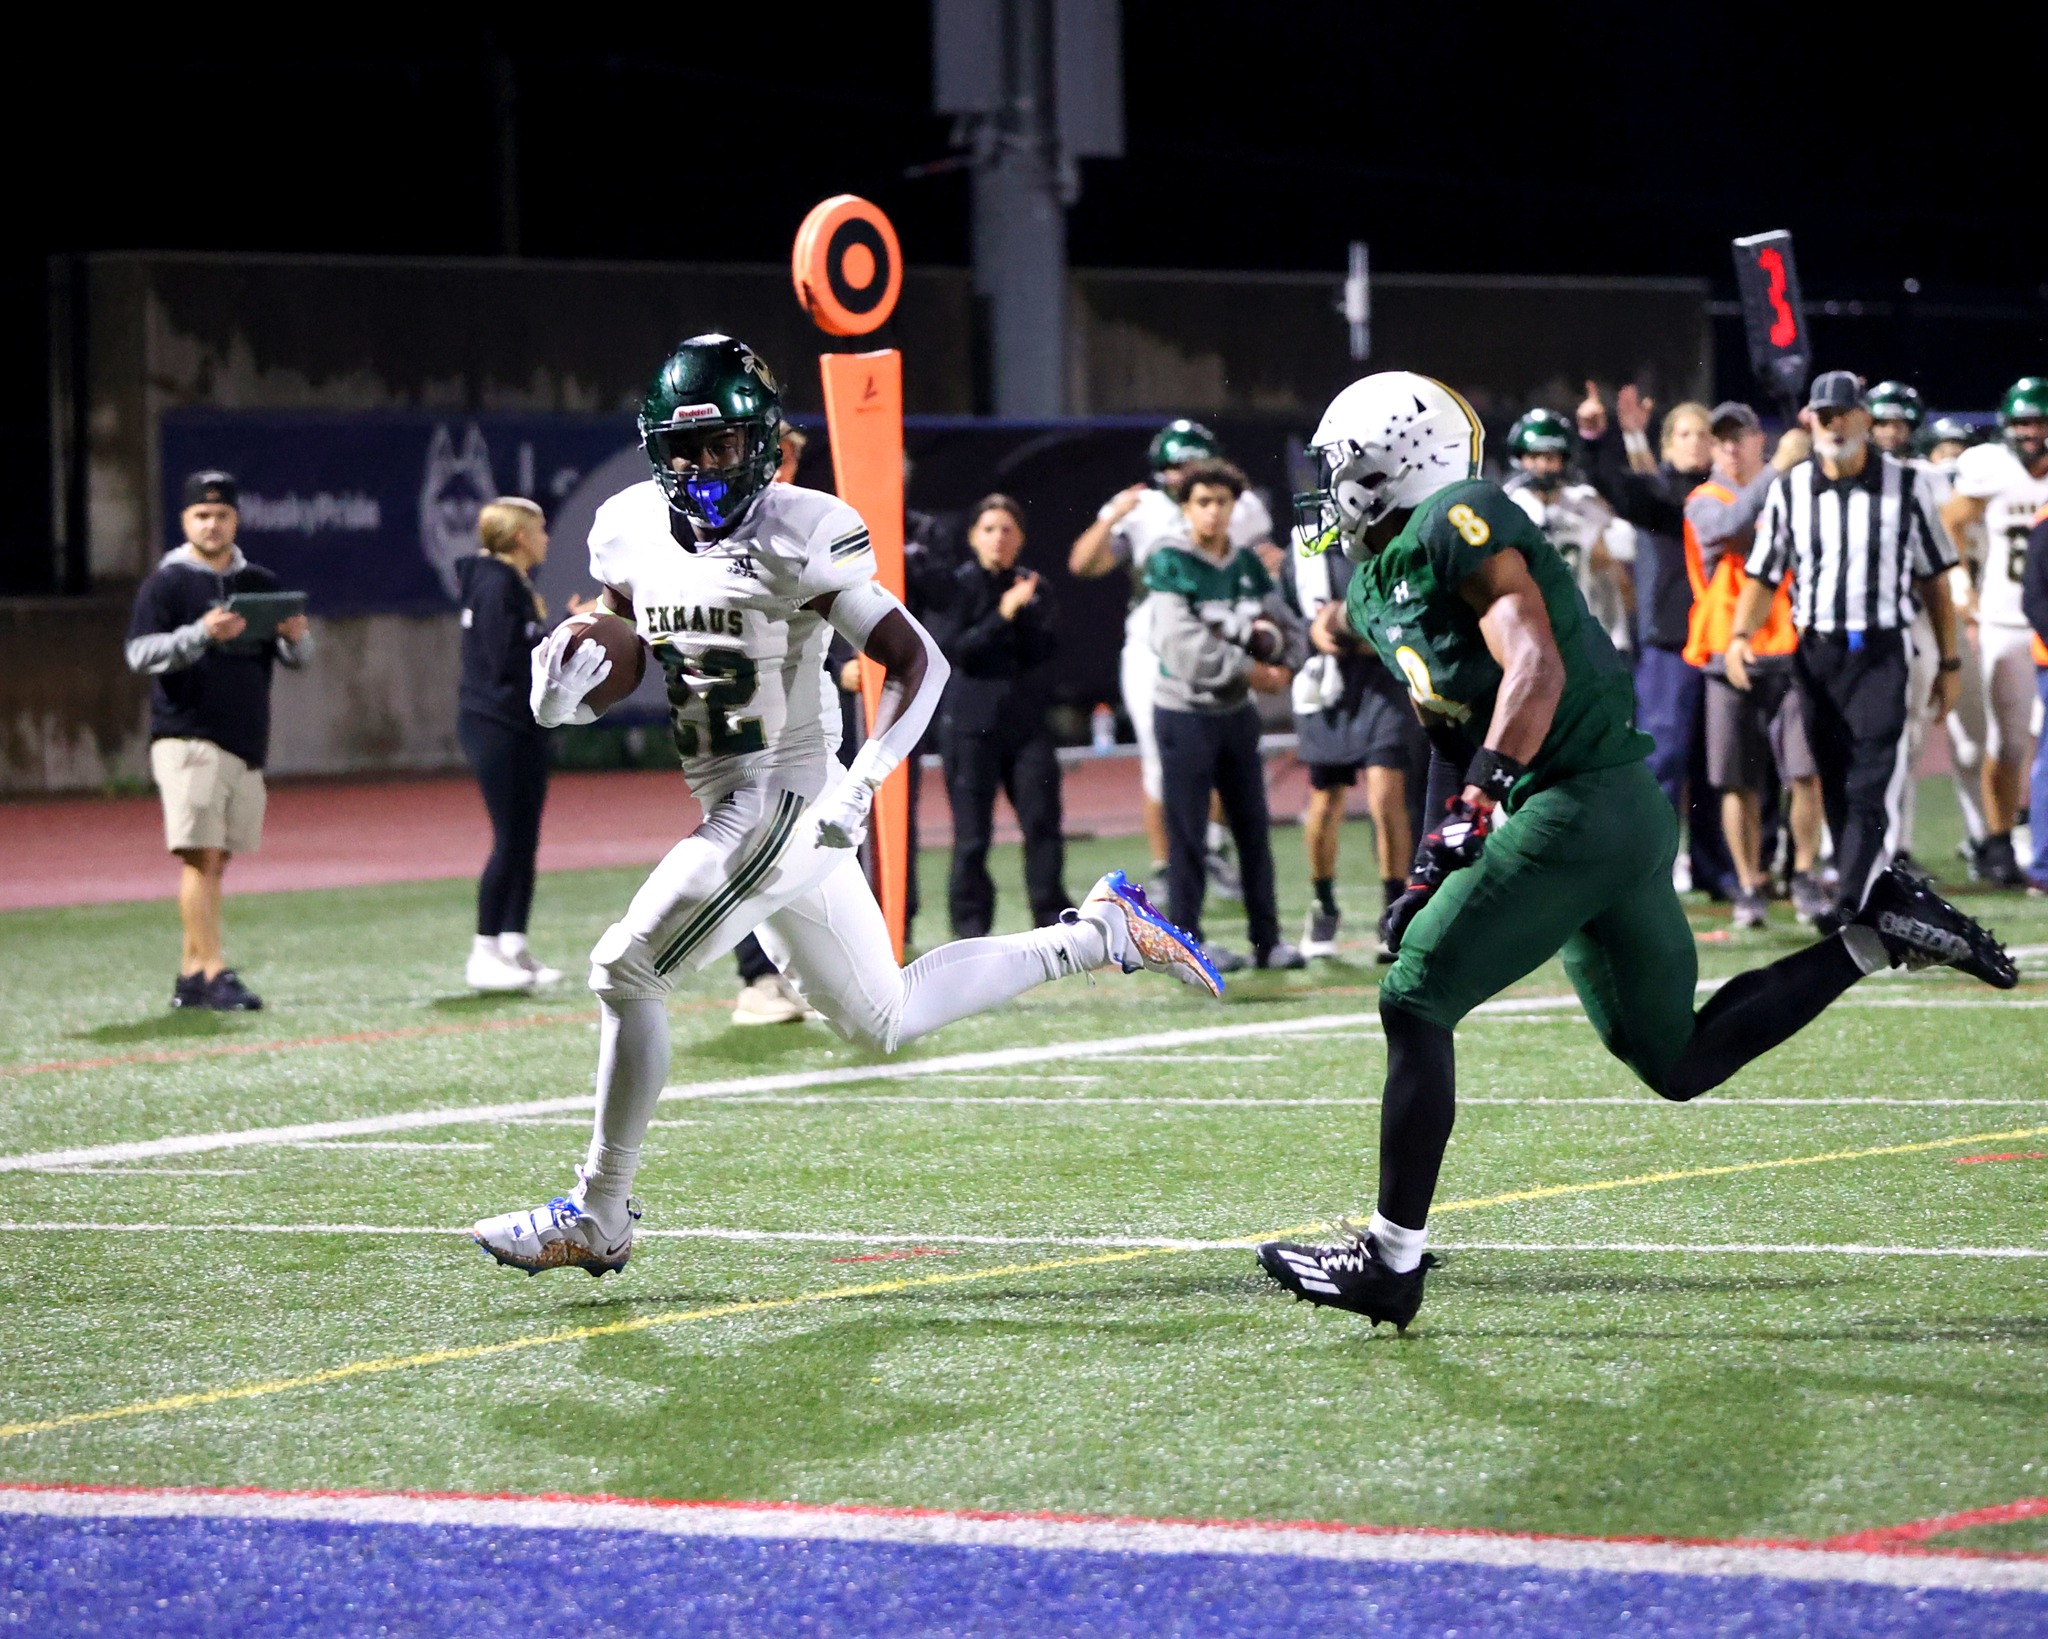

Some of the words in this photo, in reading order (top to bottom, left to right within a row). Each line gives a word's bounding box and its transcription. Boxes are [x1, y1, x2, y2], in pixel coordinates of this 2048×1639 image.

[1758, 247, 1797, 348] 3
[678, 407, 713, 418] Riddell
[1447, 503, 1490, 547] 8
